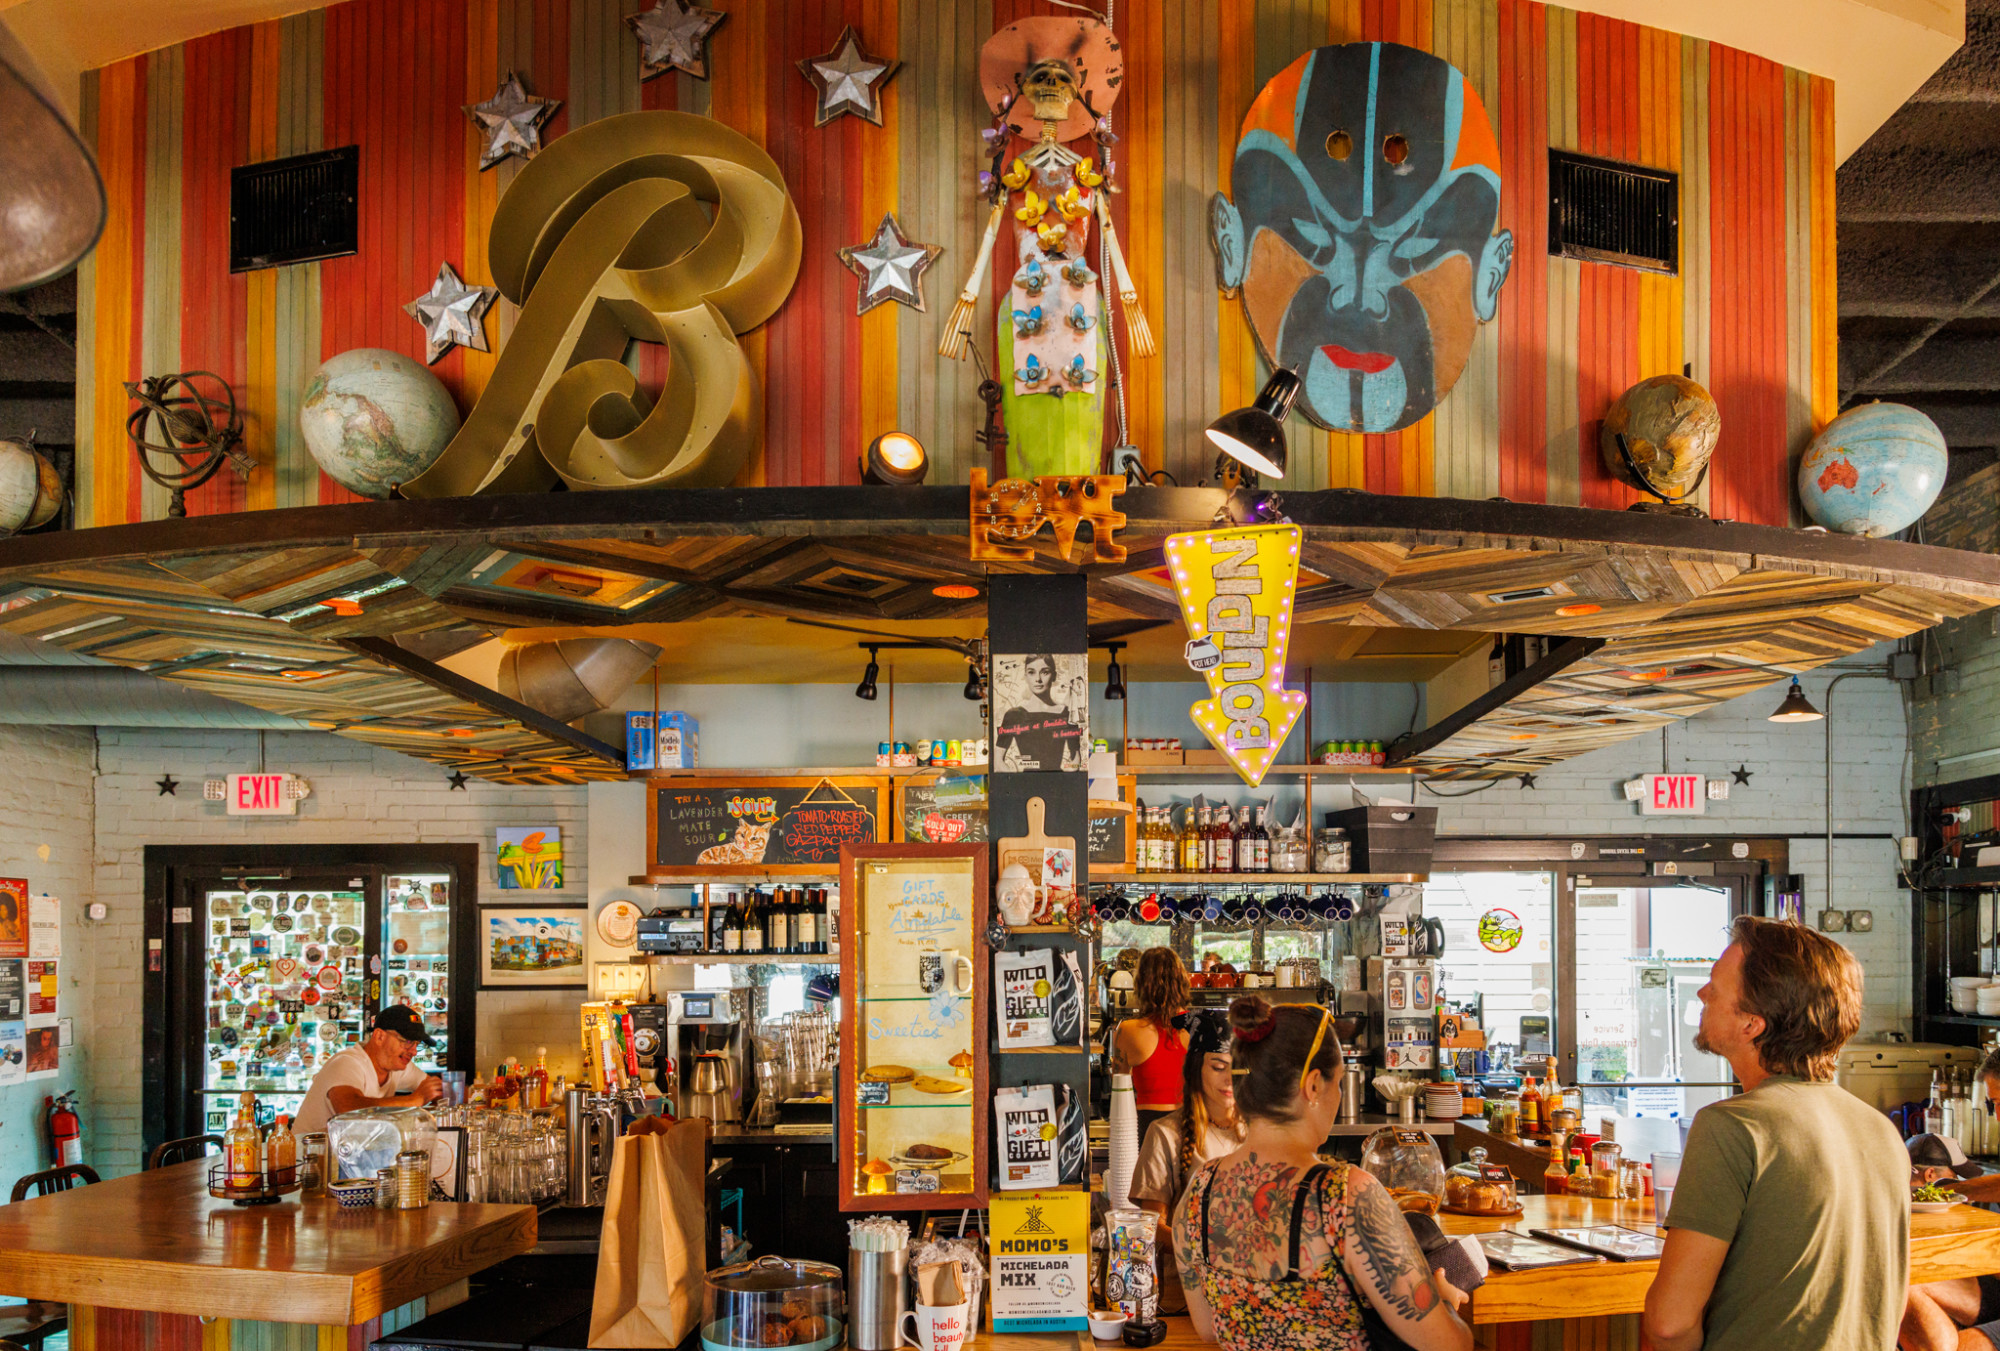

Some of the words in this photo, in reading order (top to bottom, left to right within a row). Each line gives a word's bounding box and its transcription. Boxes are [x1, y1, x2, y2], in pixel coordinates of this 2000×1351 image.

[1207, 538, 1270, 750] BOULDIN
[1194, 659, 1205, 668] POT
[1204, 657, 1217, 666] HEAD
[998, 723, 1030, 735] Breakfast
[1043, 719, 1067, 728] Bouldin
[1060, 728, 1082, 738] better!
[661, 736, 681, 745] Modelo
[238, 776, 282, 809] EXIT
[674, 795, 692, 804] TRY
[695, 794, 701, 802] A
[1654, 776, 1697, 809] EXIT
[670, 807, 723, 820] LAVENDER
[731, 796, 773, 818] SOUP
[946, 813, 973, 821] CREEK
[680, 820, 711, 833] MATE
[792, 824, 819, 835] RED
[819, 824, 862, 836] PEPPER
[926, 820, 945, 830] SOLD
[947, 823, 963, 833] OUT
[685, 833, 716, 846] SOUR
[903, 879, 935, 894] GIFT
[903, 891, 945, 907] CARDS
[889, 907, 964, 929] Available
[1385, 922, 1405, 930] WILD
[1005, 966, 1047, 982] WILD
[1007, 996, 1049, 1010] GIFT
[1007, 1007, 1048, 1016] COFFEE
[868, 1014, 944, 1040] Sweeties
[209, 1114, 225, 1125] ATX
[1006, 1109, 1049, 1126] WILD
[1008, 1140, 1050, 1153] GIFT
[1008, 1151, 1050, 1159] COFFEE
[1000, 1238, 1069, 1252] MOMO'S
[1000, 1261, 1069, 1271] MICHELADA
[1000, 1273, 1036, 1287] MIX
[932, 1317, 960, 1331] hello
